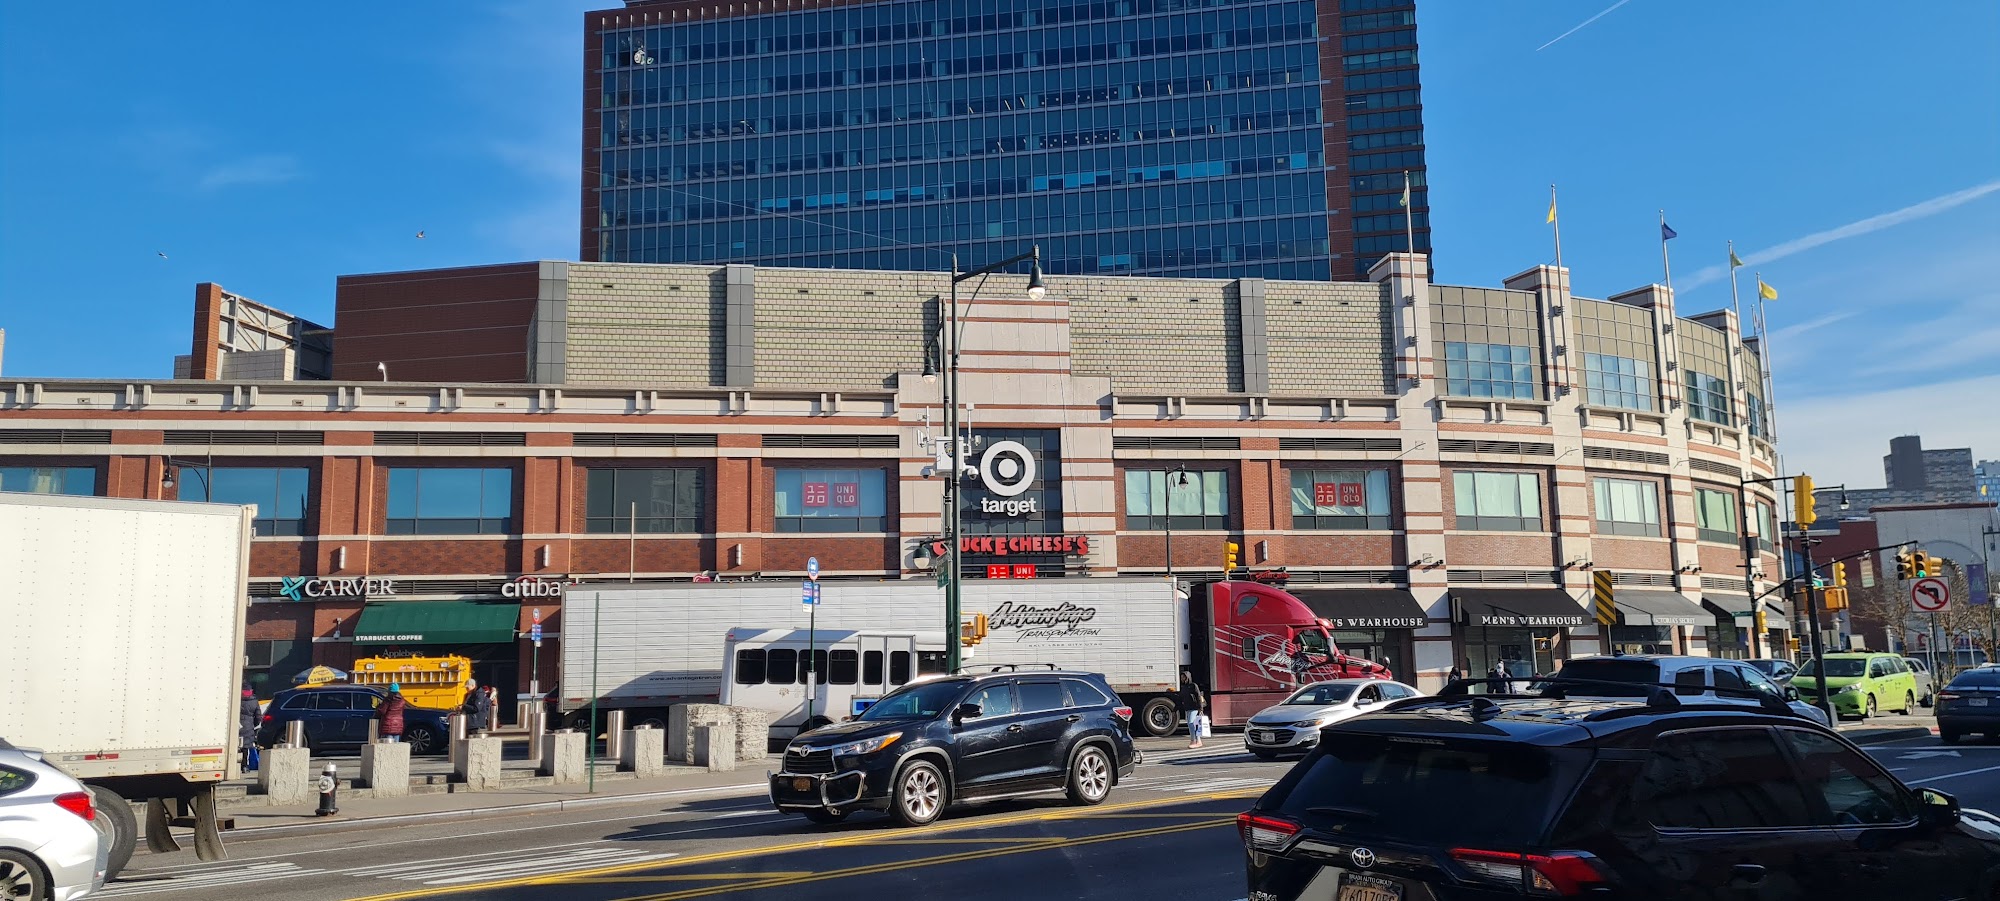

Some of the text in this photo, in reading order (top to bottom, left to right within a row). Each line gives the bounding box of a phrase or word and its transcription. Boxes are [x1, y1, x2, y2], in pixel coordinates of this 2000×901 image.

[836, 485, 853, 494] UNI
[836, 495, 855, 504] QLO
[1343, 495, 1360, 503] QLO
[981, 497, 1036, 517] target
[933, 536, 1088, 556] CUCK E CHEESE'S
[1016, 567, 1032, 575] UNI
[305, 579, 395, 597] CARVER
[501, 577, 585, 597] citiba
[1348, 618, 1424, 627] WEARHOUSE
[1482, 616, 1583, 625] MEN'S WEARHOUSE
